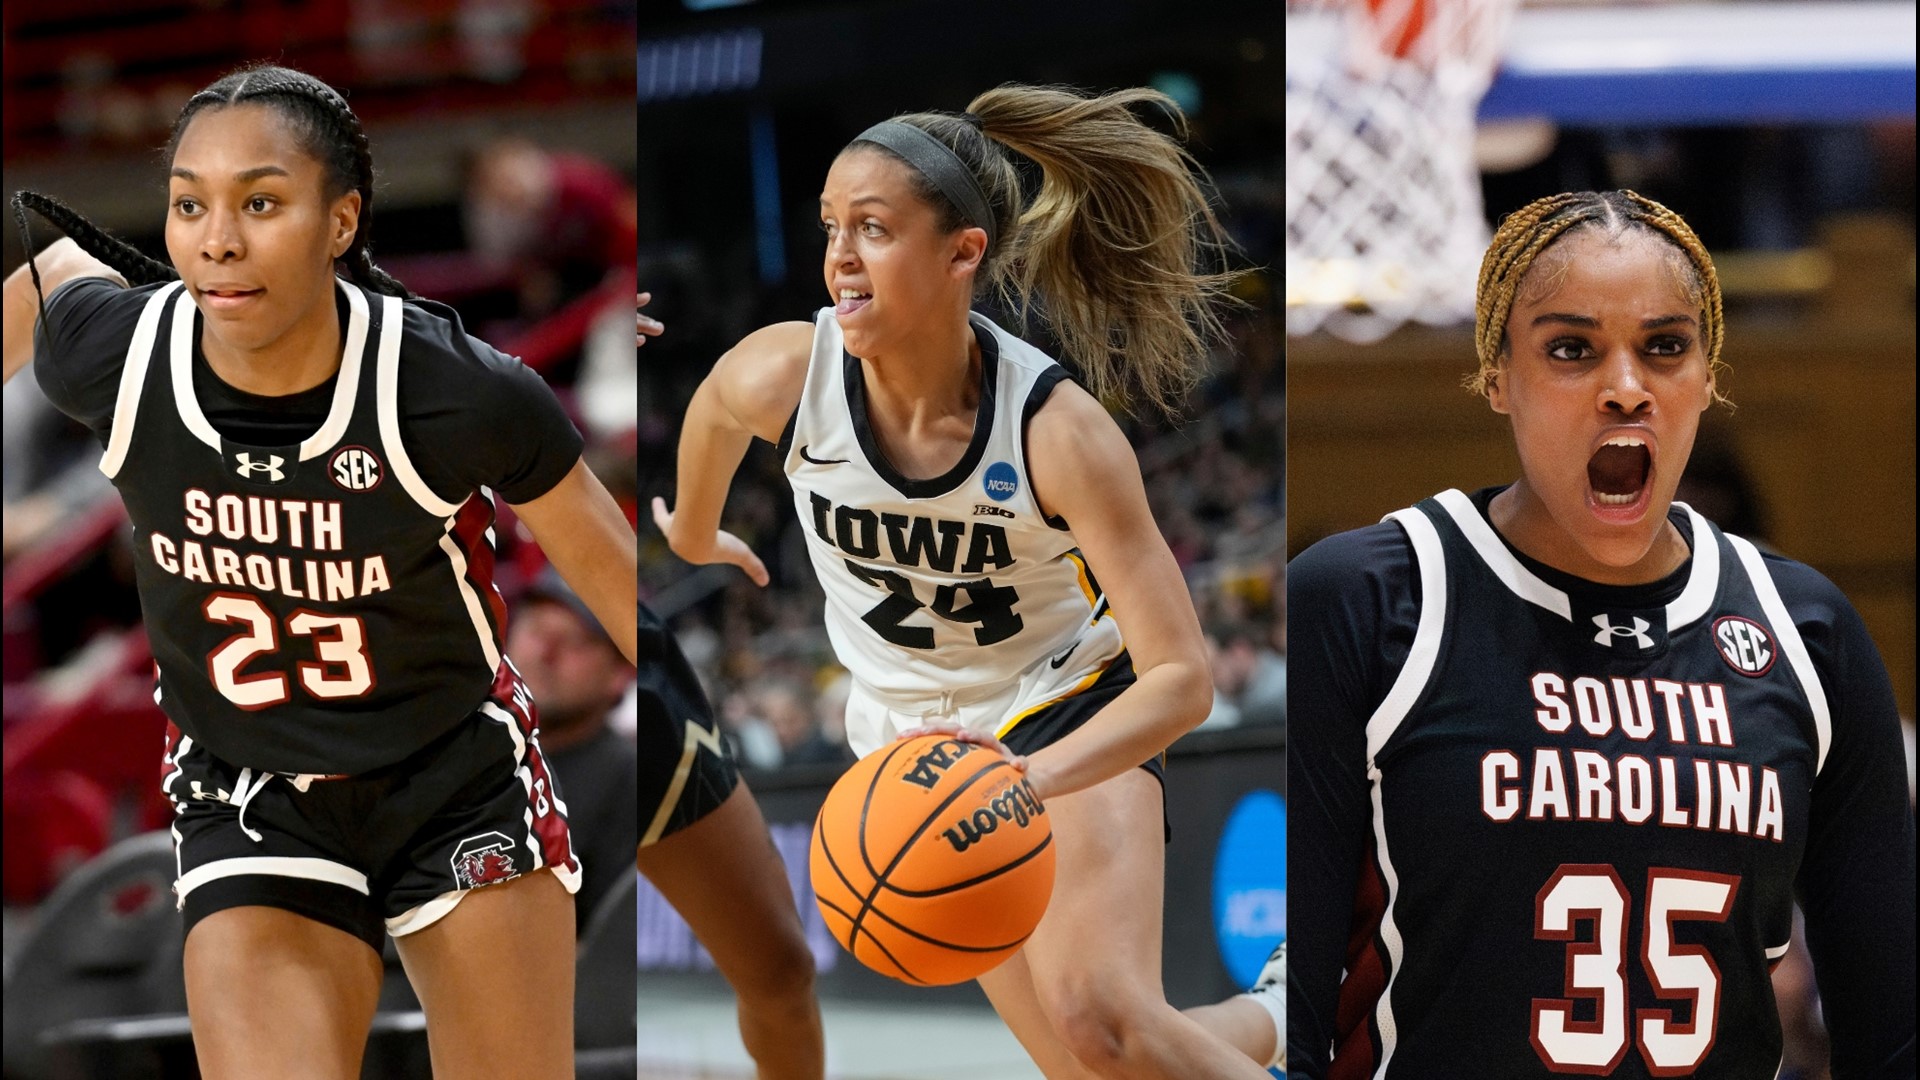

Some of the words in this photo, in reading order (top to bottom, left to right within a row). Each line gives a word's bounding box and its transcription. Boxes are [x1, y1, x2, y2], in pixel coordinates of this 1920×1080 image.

[333, 450, 379, 489] SEC
[987, 479, 1016, 492] NCAA
[184, 488, 343, 551] SOUTH
[809, 490, 1017, 573] IOWA
[150, 530, 391, 602] CAROLINA
[843, 558, 1024, 649] 24
[201, 591, 377, 711] 23
[1717, 620, 1771, 671] SEC
[1529, 671, 1736, 748] SOUTH
[902, 739, 977, 789] CAA
[1480, 747, 1785, 843] CAROLINA
[1529, 863, 1742, 1077] 35
